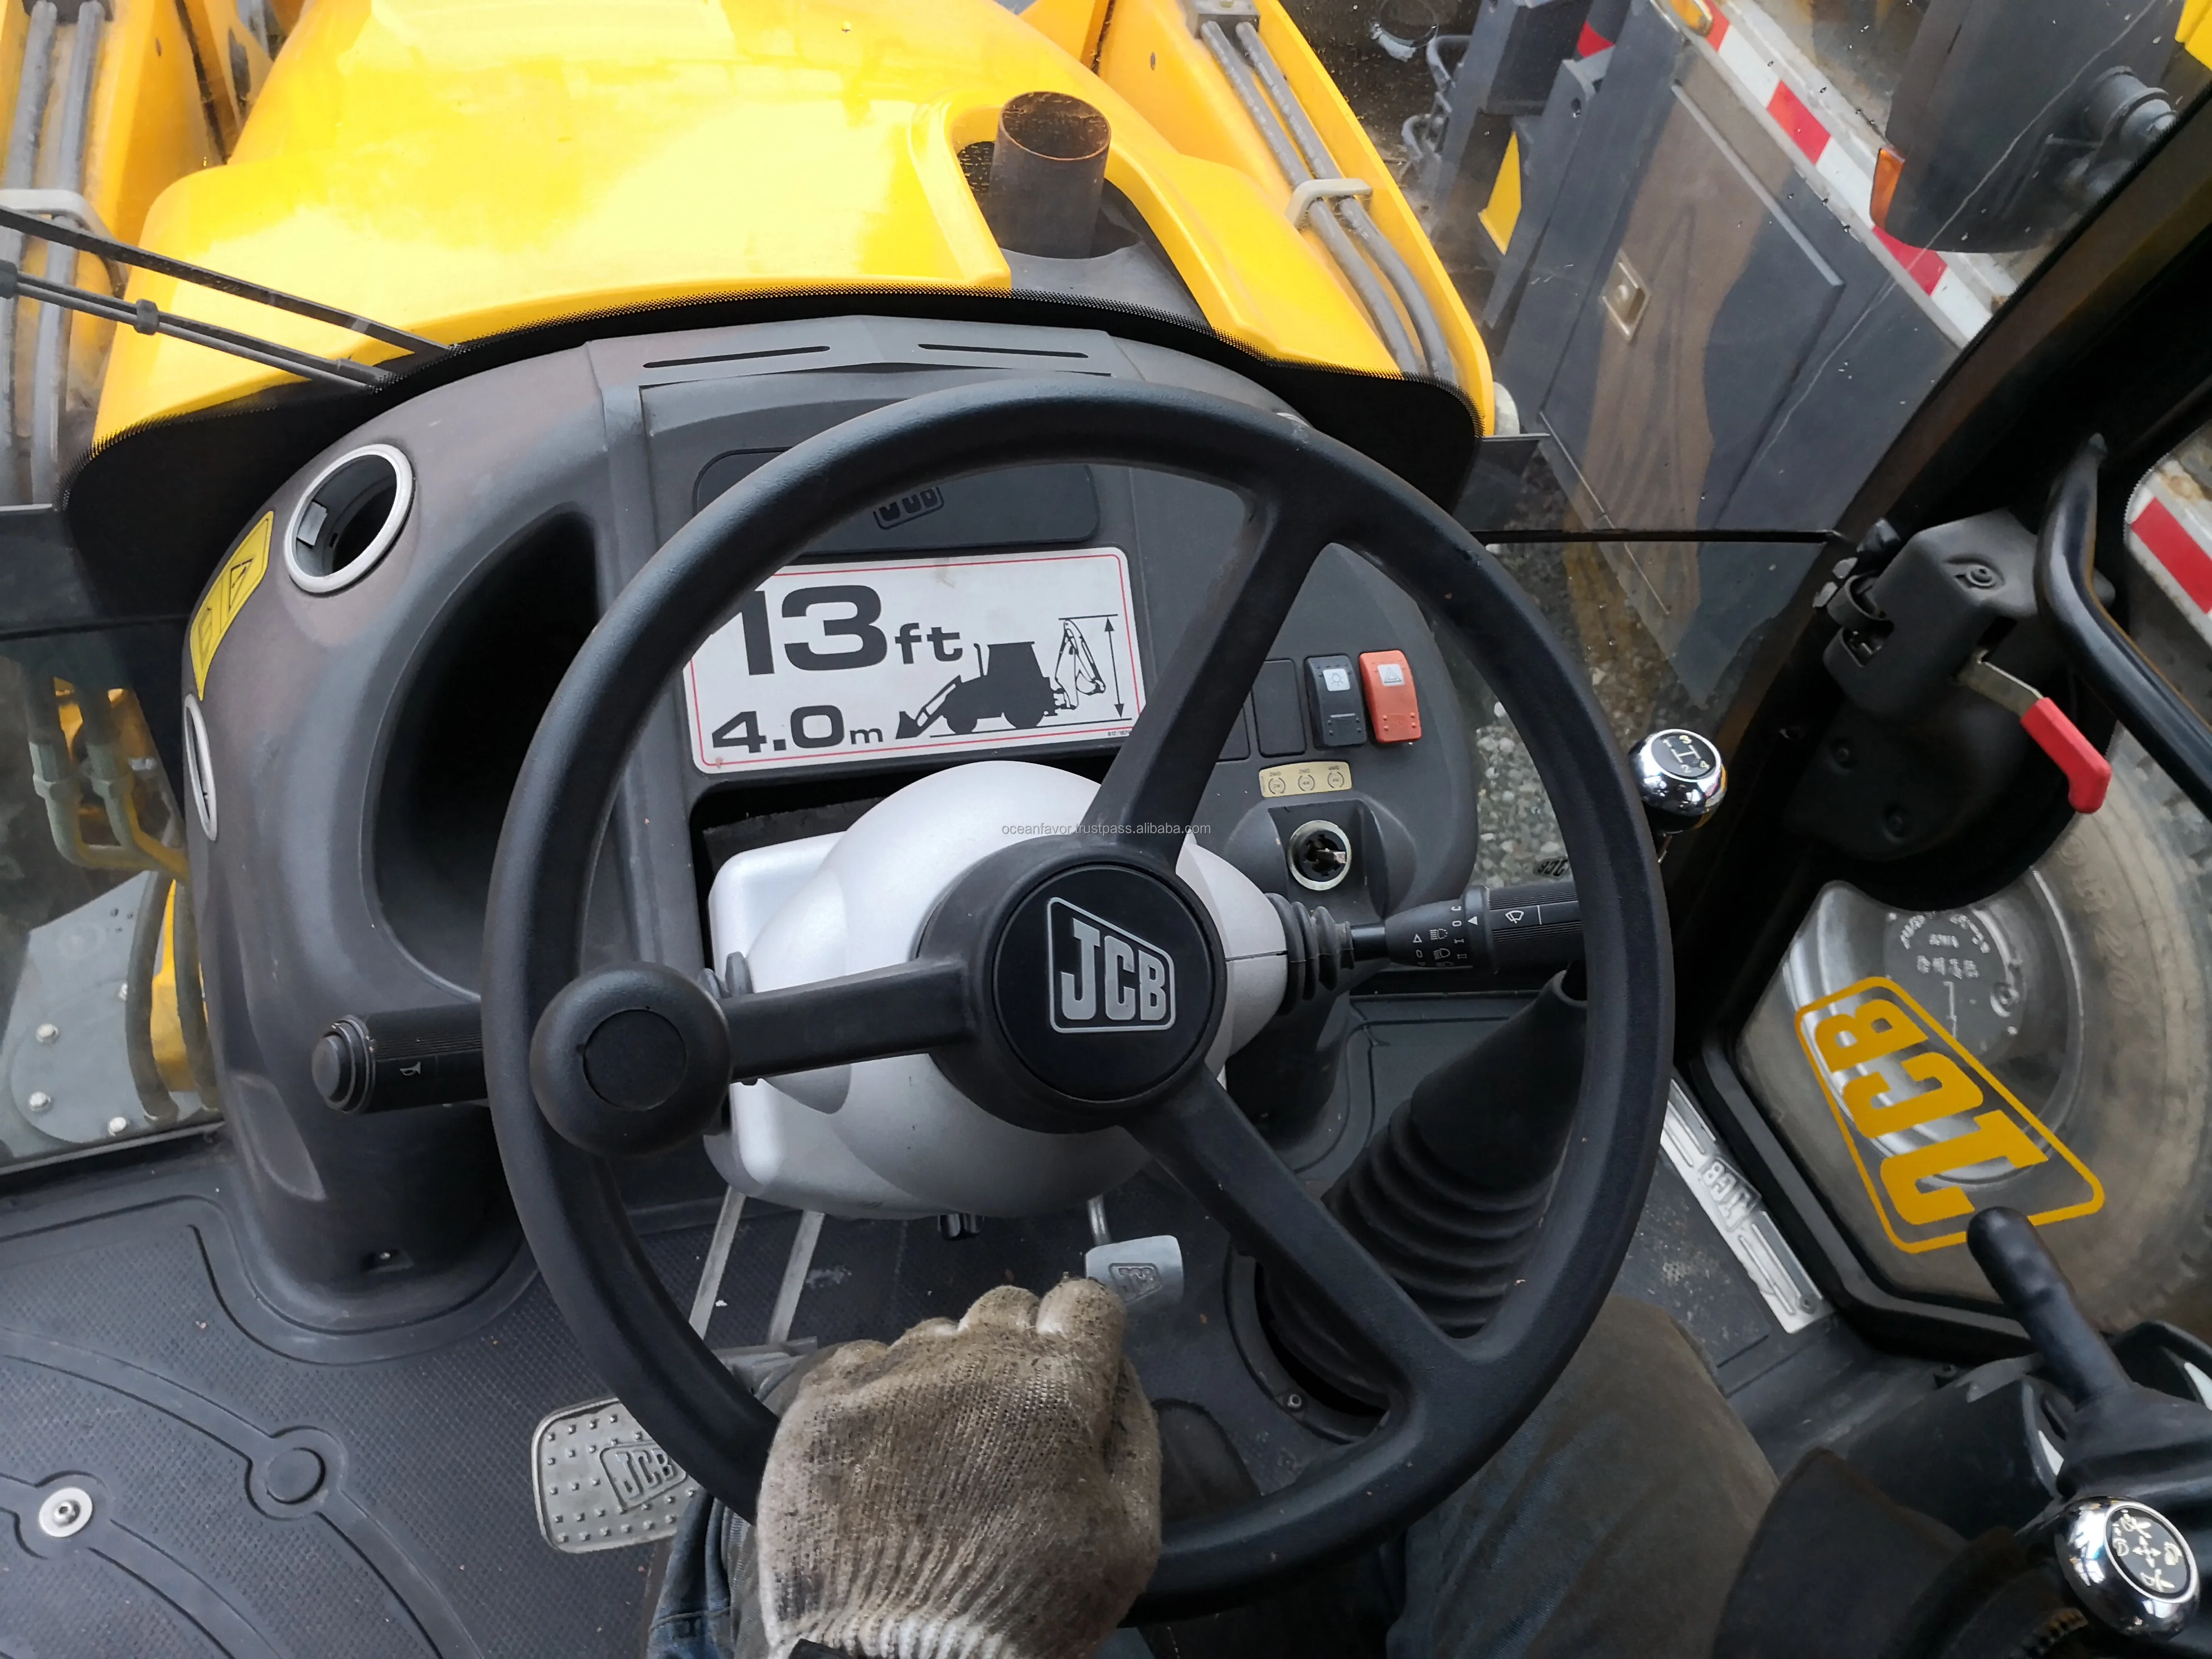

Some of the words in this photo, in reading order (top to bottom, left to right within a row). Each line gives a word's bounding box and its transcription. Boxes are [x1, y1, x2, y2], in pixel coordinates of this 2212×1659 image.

[1679, 735, 1692, 744] 3
[1680, 764, 1692, 774] 2
[1699, 760, 1710, 770] 4
[1060, 918, 1167, 1021] JCB
[615, 1449, 678, 1500] JCB
